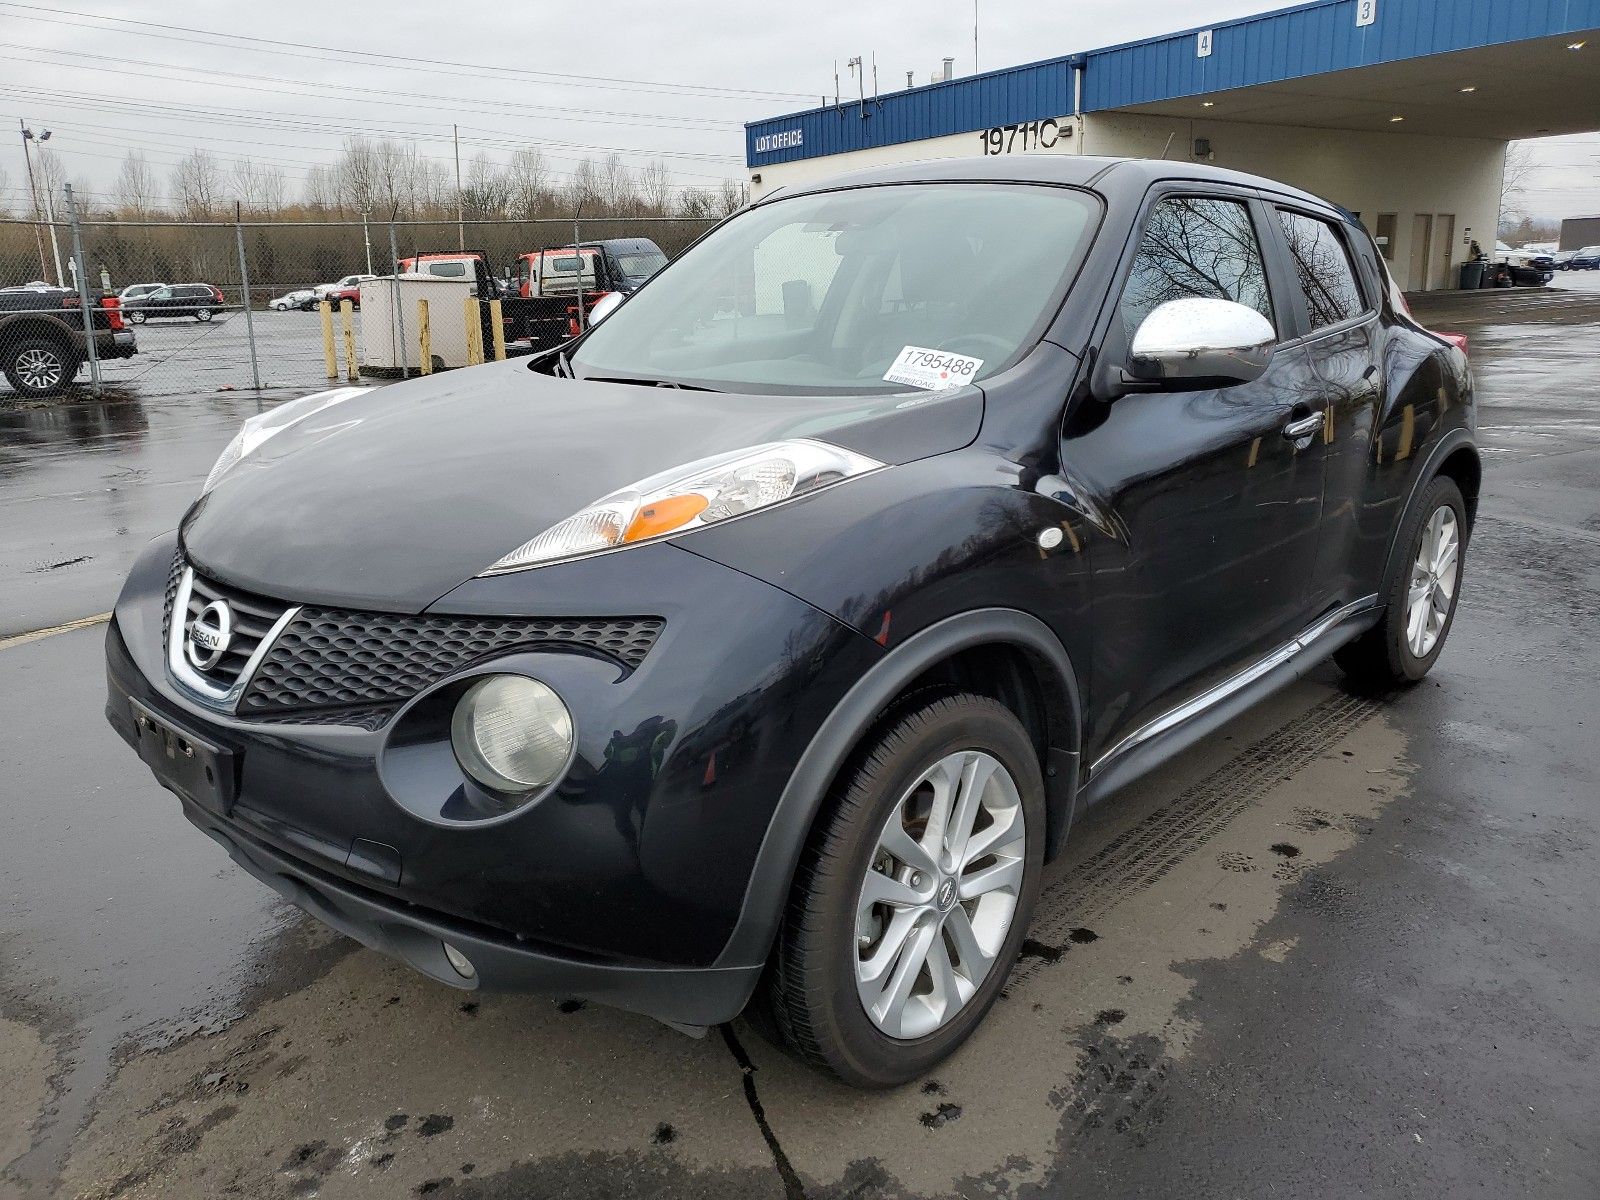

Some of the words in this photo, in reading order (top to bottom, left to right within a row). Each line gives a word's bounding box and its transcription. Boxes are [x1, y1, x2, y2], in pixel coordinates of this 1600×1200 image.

[1362, 2, 1371, 19] 3
[1201, 35, 1208, 51] 4
[756, 136, 770, 152] LOT
[772, 130, 803, 149] OFFICE
[980, 118, 1058, 155] 19711C
[904, 350, 975, 375] 1795488
[191, 627, 220, 647] SSAN
